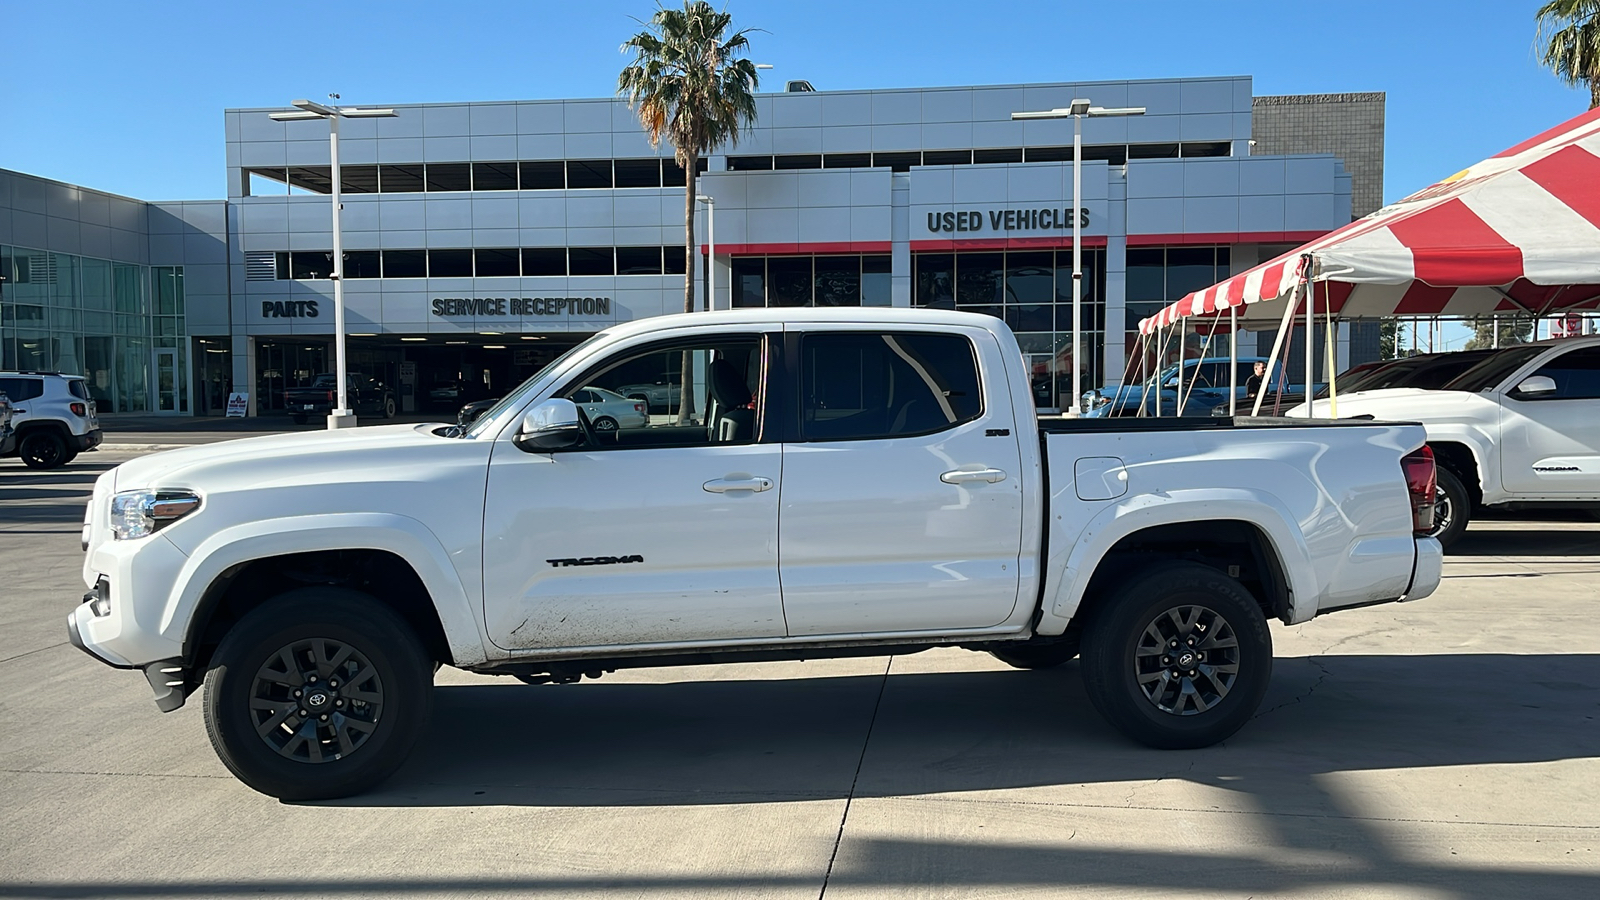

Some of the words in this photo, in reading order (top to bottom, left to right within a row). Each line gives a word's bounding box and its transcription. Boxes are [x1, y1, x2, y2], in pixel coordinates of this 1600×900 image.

[927, 211, 983, 233] USED
[989, 207, 1090, 231] VEHICLES
[262, 300, 319, 318] PARTS
[432, 298, 507, 316] SERVICE
[510, 297, 610, 316] RECEPTION
[546, 554, 644, 568] TACOMA
